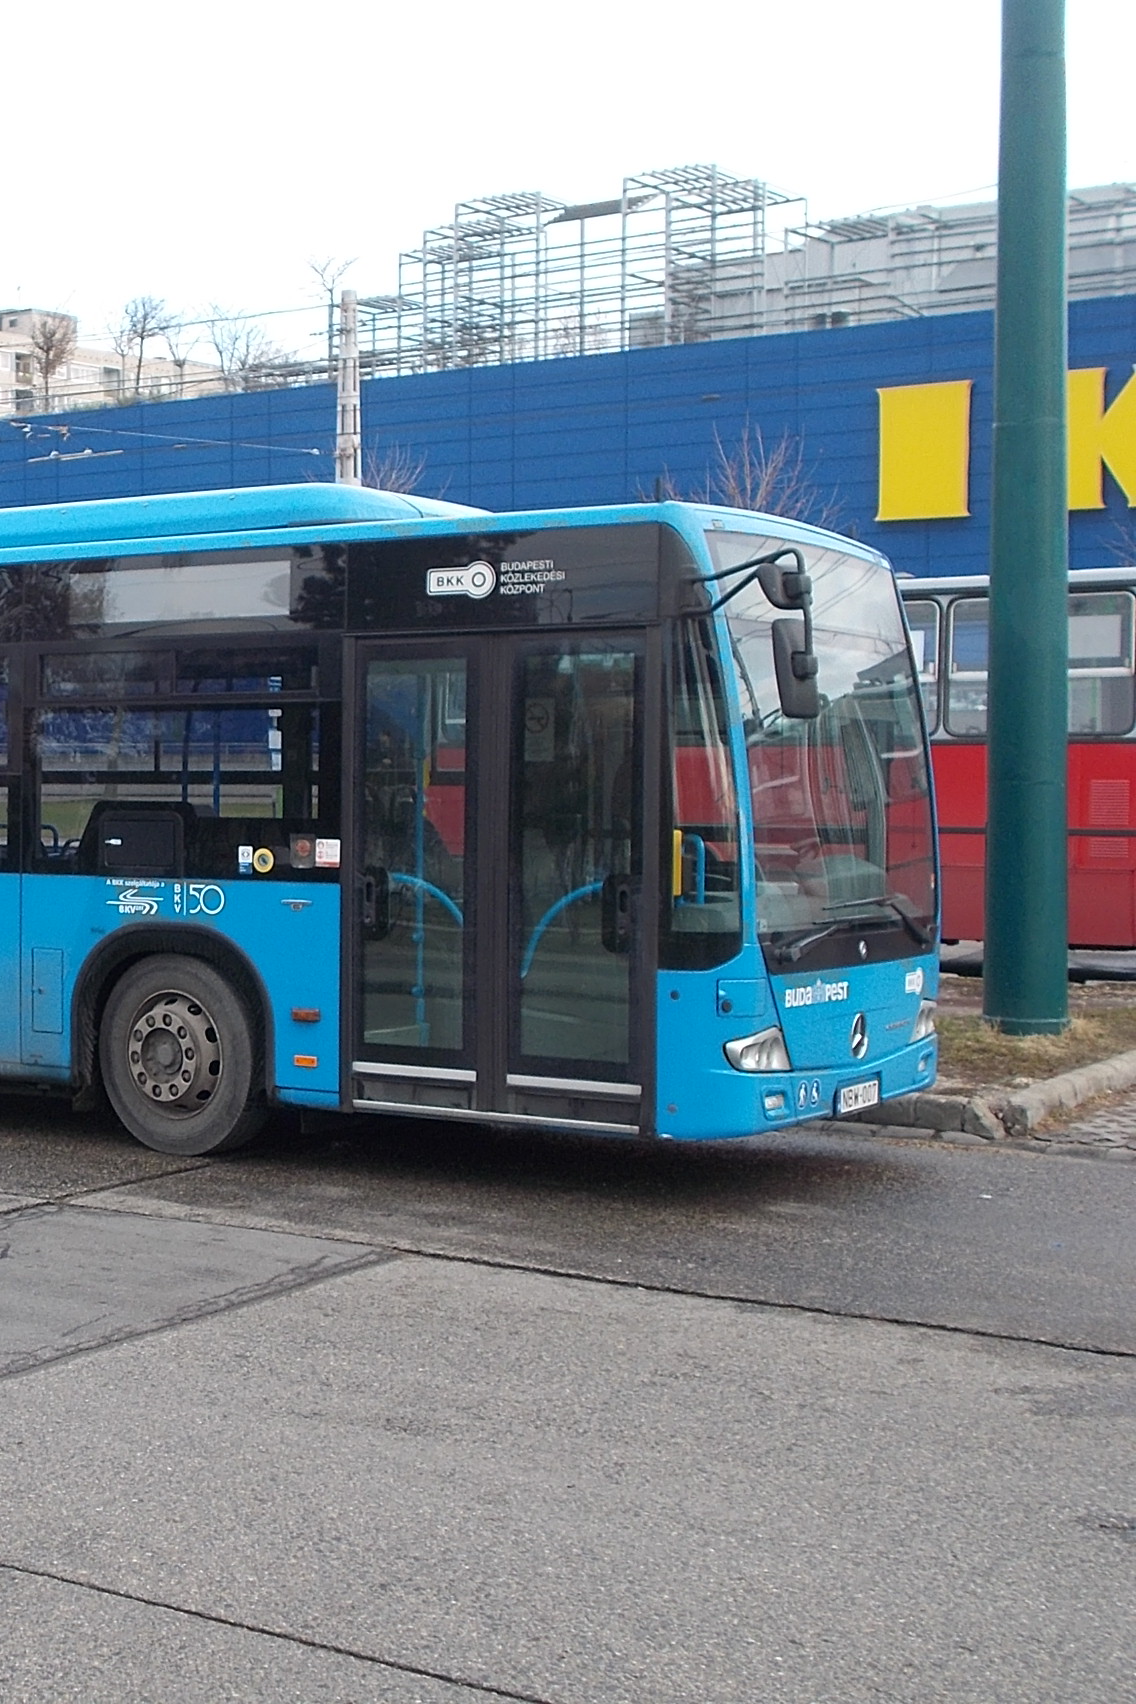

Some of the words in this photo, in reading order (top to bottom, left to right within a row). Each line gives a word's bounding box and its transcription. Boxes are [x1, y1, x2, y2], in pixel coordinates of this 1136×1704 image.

[500, 560, 554, 572] BUDAPESTI
[436, 575, 465, 588] BKK
[500, 570, 566, 583] KÖZLEKEDÉSI
[500, 583, 546, 595] KÖZPONT
[189, 884, 225, 915] 50
